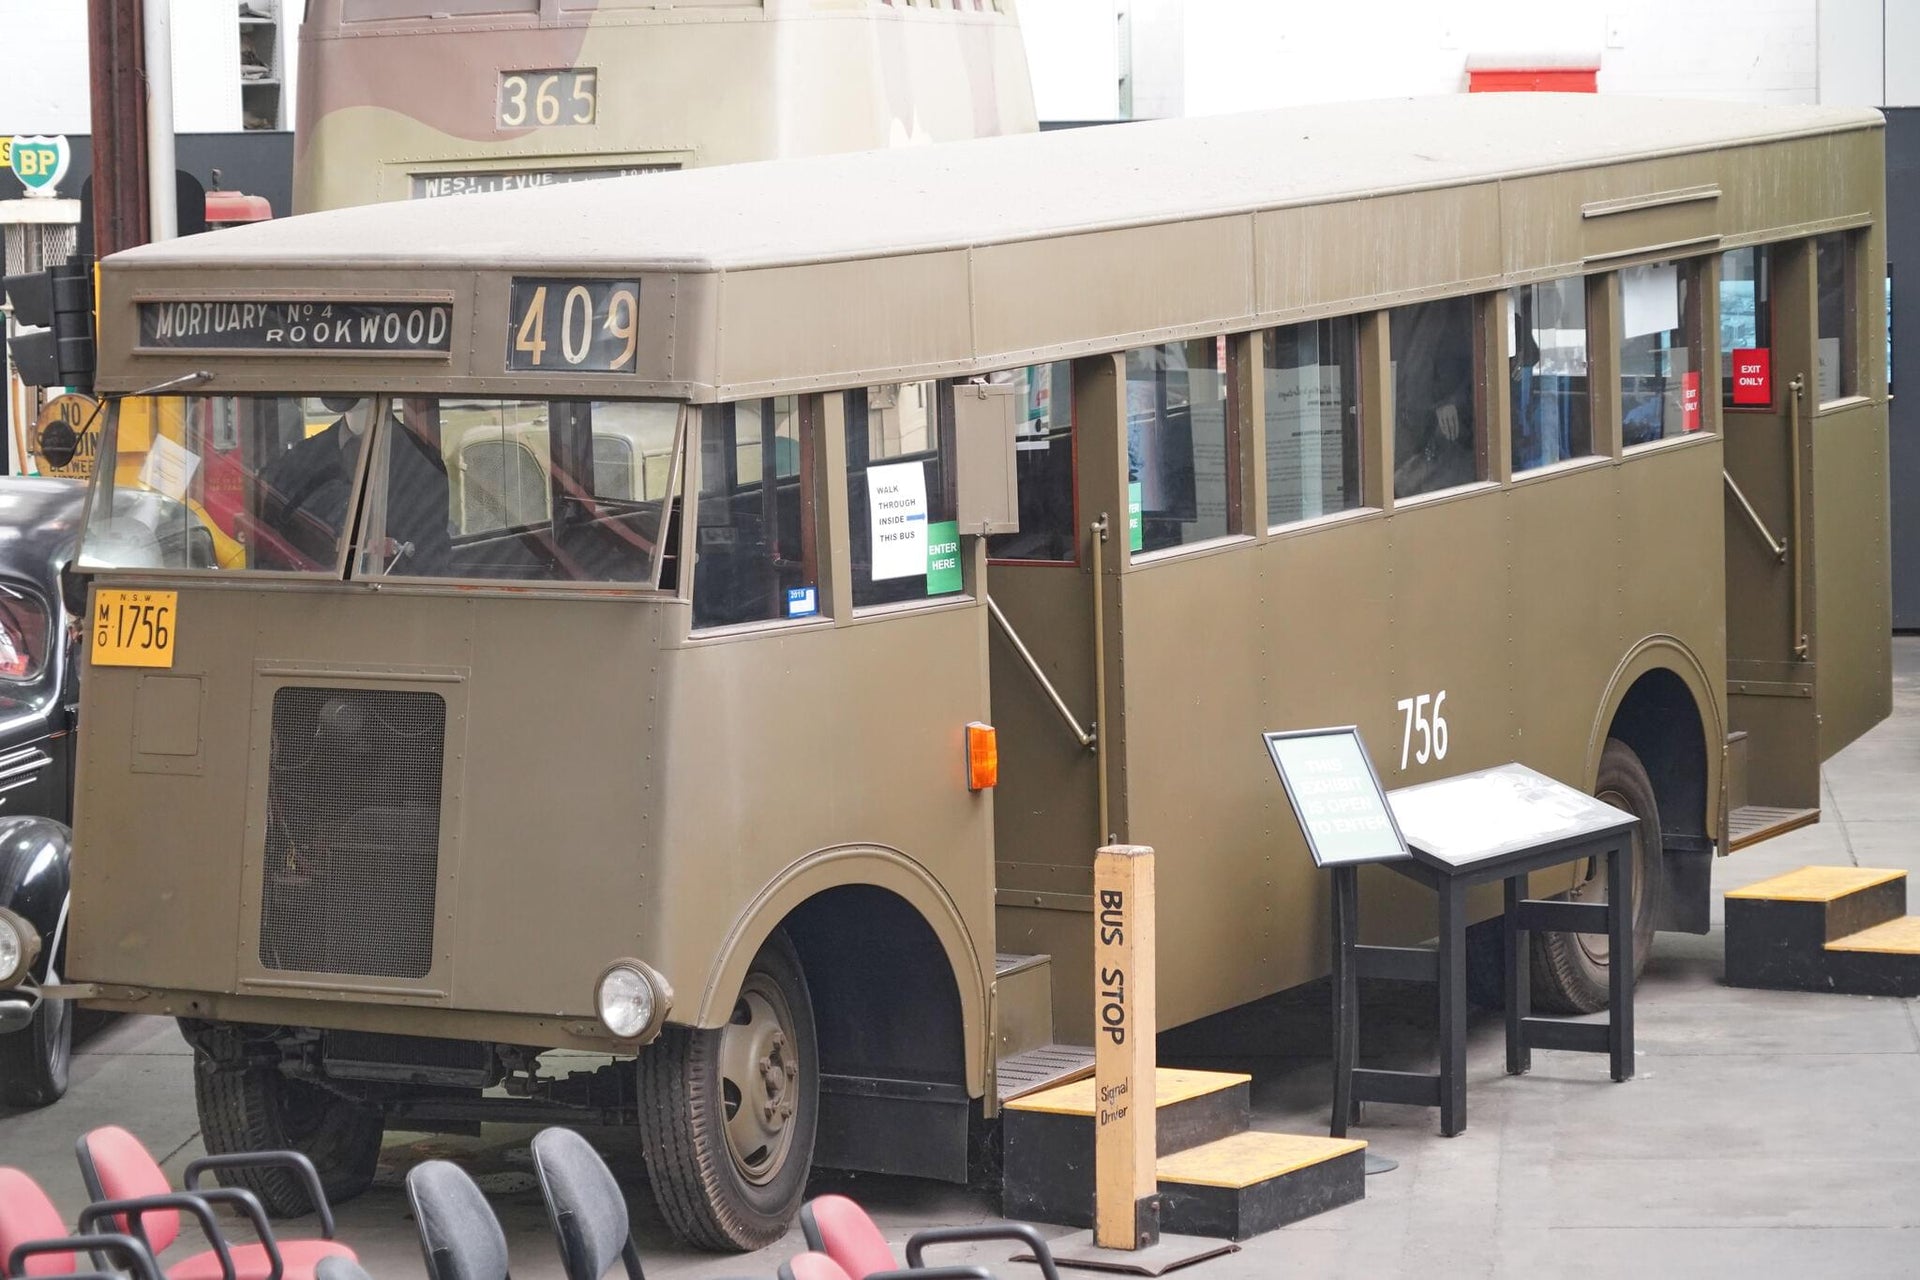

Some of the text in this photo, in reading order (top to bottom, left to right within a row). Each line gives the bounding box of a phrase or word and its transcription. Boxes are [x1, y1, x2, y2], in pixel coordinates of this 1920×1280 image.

[502, 75, 596, 126] 365
[19, 149, 55, 175] BP
[425, 176, 477, 198] WEST
[452, 173, 553, 196] LEVUE
[156, 303, 267, 339] MORTUARY
[321, 304, 332, 318] 4
[266, 307, 447, 344] ROOKWOOD
[516, 285, 637, 369] 409
[1741, 365, 1761, 373] EXIT
[1739, 377, 1764, 386] ONLY
[61, 402, 81, 427] NO
[876, 485, 899, 494] WALK
[878, 499, 916, 510] THROUGH
[879, 516, 904, 525] INSIDE
[880, 531, 915, 542] THIS BUS
[929, 542, 957, 555] ENTER
[932, 558, 955, 570] HERE
[117, 605, 168, 649] 1756
[1397, 690, 1448, 770] 756
[1304, 758, 1343, 774] THIS
[1300, 776, 1362, 796] EXHIBIT
[1306, 796, 1373, 814] IS OPEN
[1311, 815, 1386, 834] TO ENTER
[1100, 890, 1125, 1046] BUS STOP
[1101, 1077, 1128, 1106] Signal
[1101, 1105, 1128, 1126] Driver
